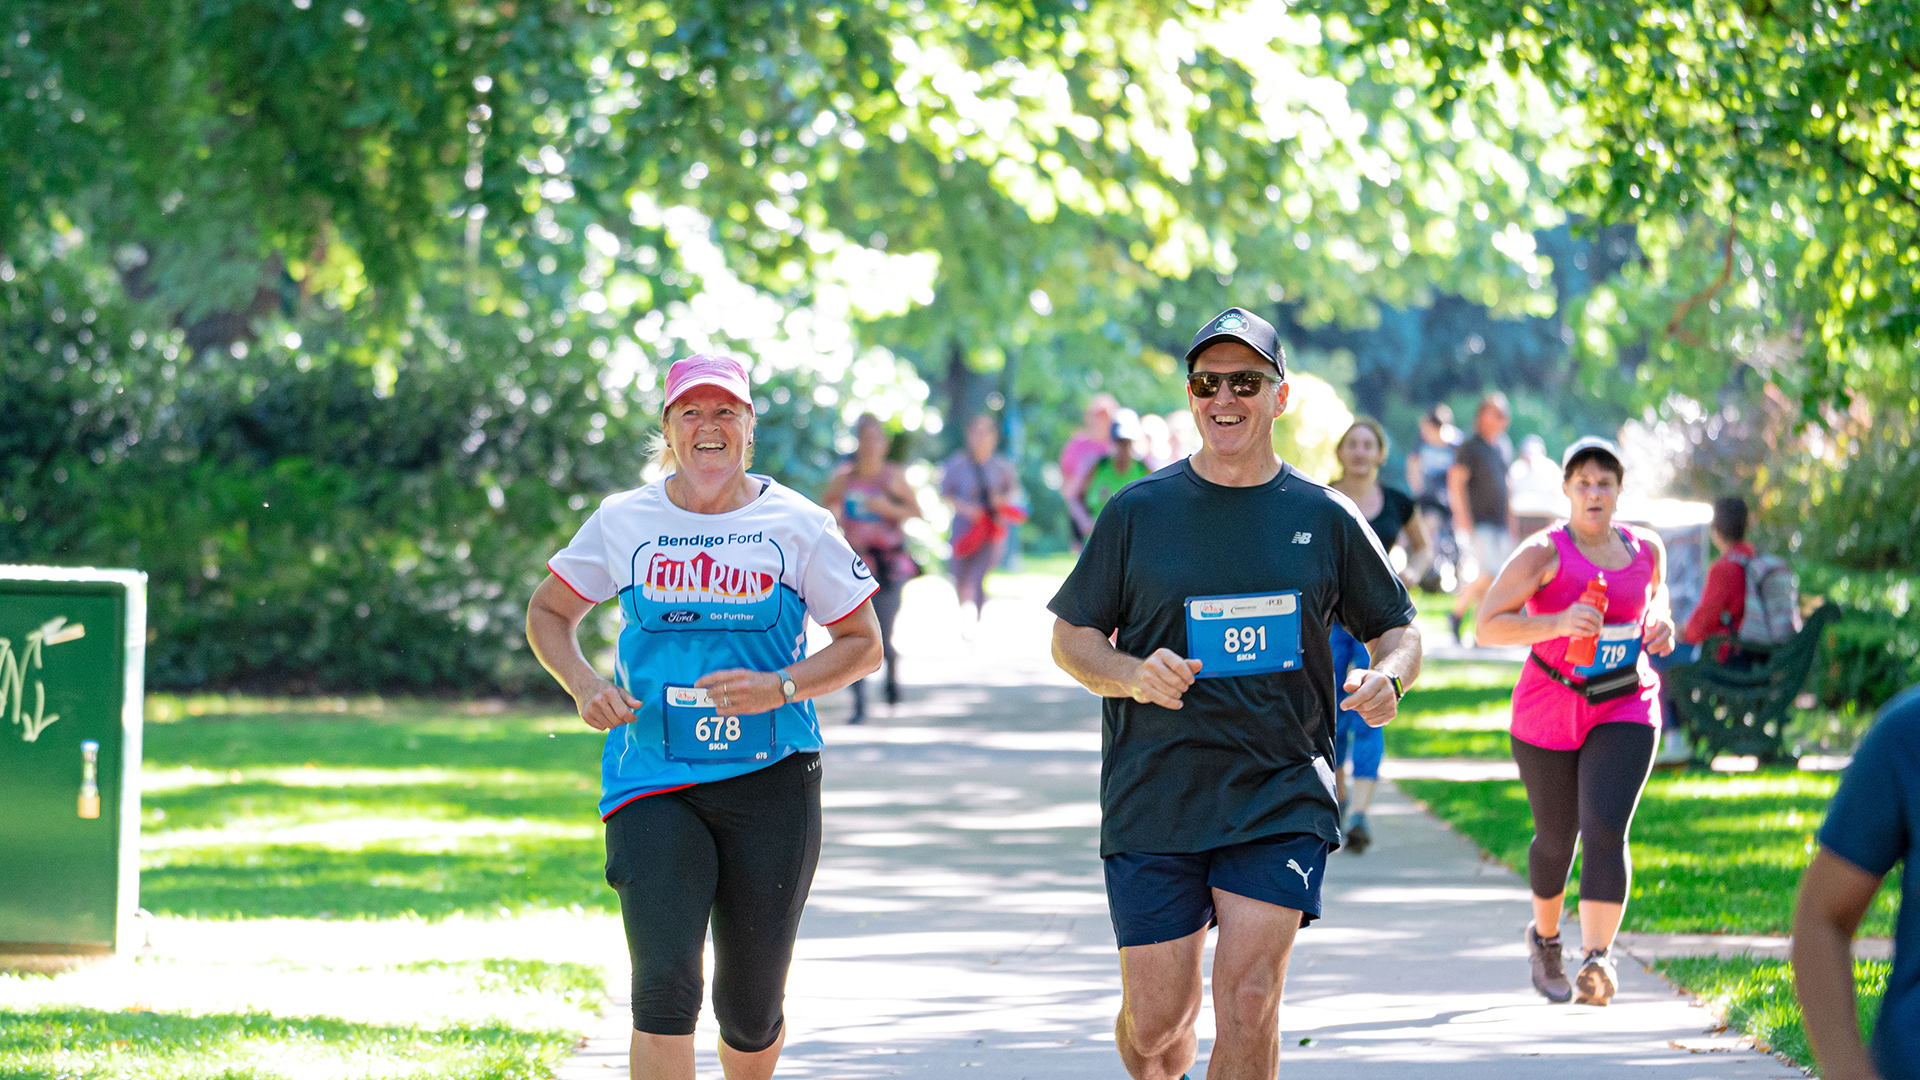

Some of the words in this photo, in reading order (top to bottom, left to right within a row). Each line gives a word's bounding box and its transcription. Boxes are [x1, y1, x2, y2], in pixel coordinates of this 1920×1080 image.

[658, 535, 724, 548] Bendigo
[728, 531, 762, 544] Ford
[1291, 531, 1312, 545] NB
[651, 555, 703, 593] FUN
[708, 561, 762, 598] RUN
[667, 610, 695, 623] Ford
[724, 613, 754, 621] Further
[1224, 625, 1267, 653] 891
[1601, 644, 1626, 664] 719
[695, 716, 741, 741] 678
[708, 743, 728, 751] 5KM
